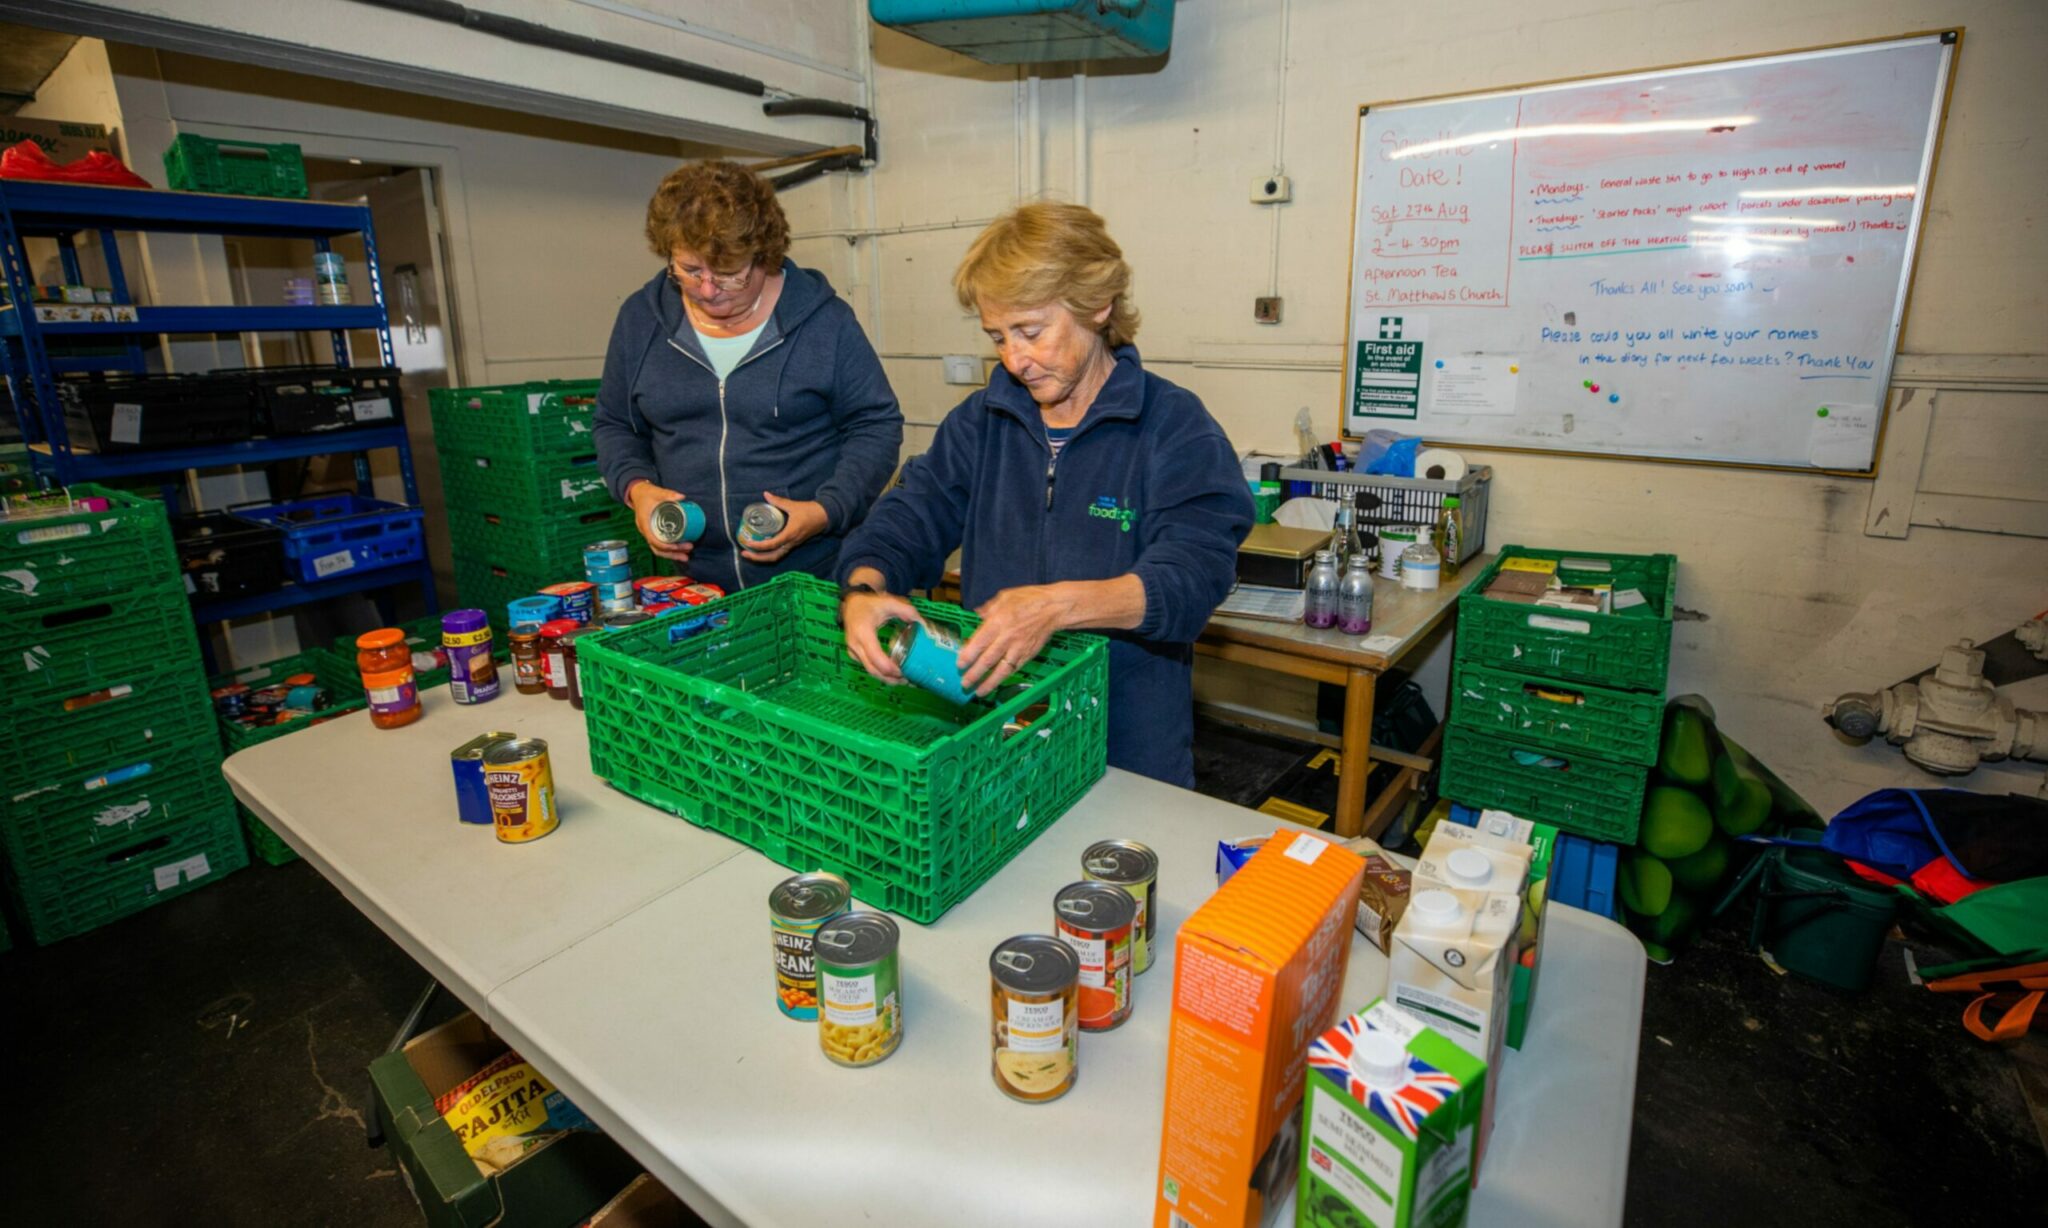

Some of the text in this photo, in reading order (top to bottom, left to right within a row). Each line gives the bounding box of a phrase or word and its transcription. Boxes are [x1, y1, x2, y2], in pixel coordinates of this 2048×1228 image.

[1600, 177, 1632, 189] General
[1687, 171, 1697, 181] to
[1701, 172, 1713, 186] go
[1718, 170, 1727, 178] to
[1732, 168, 1756, 181] High
[1775, 163, 1793, 175] end
[1797, 163, 1809, 175] of
[1371, 204, 1399, 222] Sat
[1437, 202, 1470, 224] Aug
[1666, 204, 1692, 218] might
[1561, 241, 1594, 253] SWITCH
[1600, 238, 1617, 248] OFF
[1622, 237, 1640, 247] THE
[1647, 234, 1688, 246] HEATING
[1364, 264, 1458, 285] Afternoon Tea
[1590, 278, 1635, 296] Thanks
[1671, 280, 1695, 295] See
[1698, 284, 1720, 300] you
[1541, 326, 1819, 348] Please could you all write your names
[1365, 343, 1416, 356] First aid
[1579, 354, 1590, 364] in
[1594, 353, 1616, 364] the
[1620, 352, 1648, 367] diary
[1654, 352, 1672, 366] for
[1676, 353, 1707, 364] next
[1711, 353, 1734, 366] few
[1798, 352, 1842, 369] Thank
[1846, 352, 1875, 370] You
[489, 773, 519, 784] HEINZ
[774, 932, 813, 952] HEINZ
[1070, 938, 1090, 950] TESCO
[836, 980, 859, 989] TESCO
[1024, 1005, 1049, 1015] TESCO
[455, 1078, 547, 1145] FAJITA
[459, 1093, 482, 1116] OLD
[1339, 1110, 1377, 1145] TESCO
